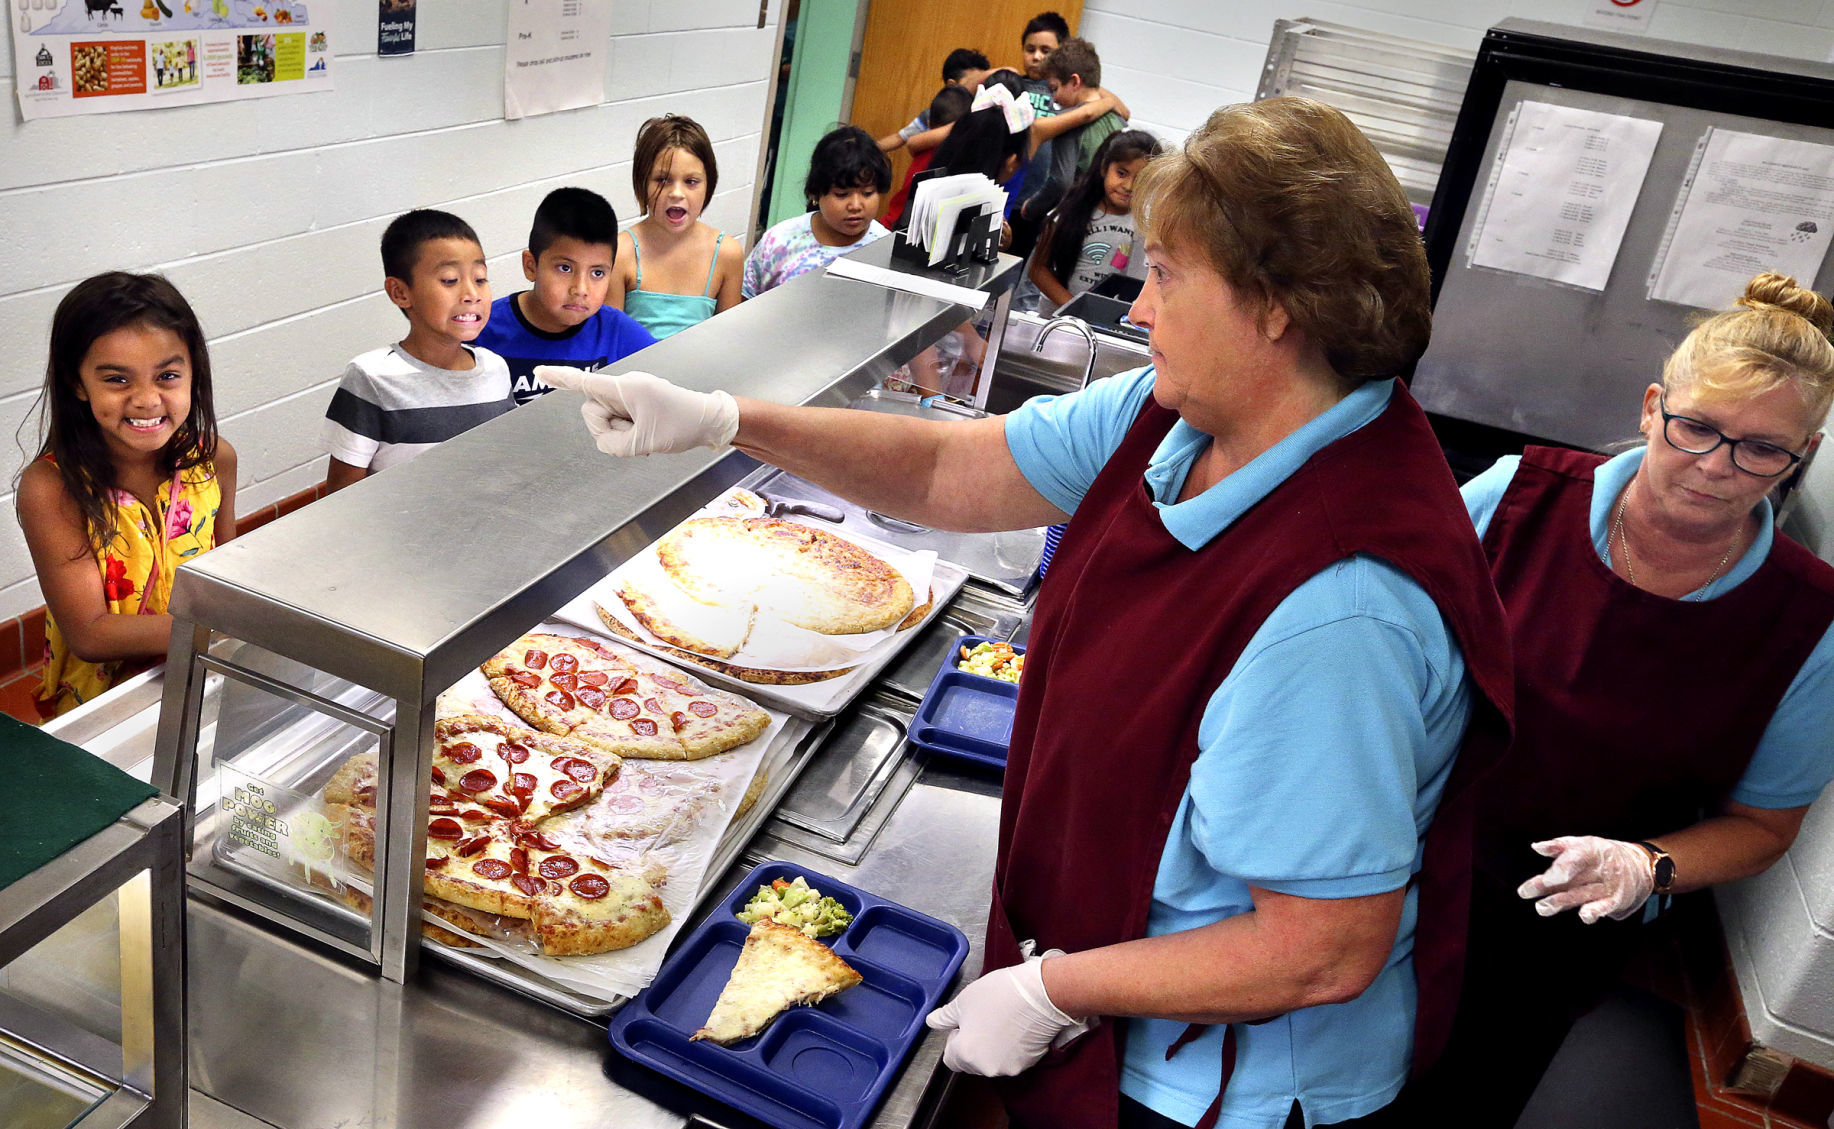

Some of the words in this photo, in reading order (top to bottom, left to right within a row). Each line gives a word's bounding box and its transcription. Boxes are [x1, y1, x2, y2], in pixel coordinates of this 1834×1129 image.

[380, 21, 403, 32] Fueling
[1029, 92, 1050, 110] PIC
[235, 787, 275, 814] MOO
[247, 783, 264, 796] Get
[222, 797, 288, 836] POWER
[232, 816, 244, 827] by
[246, 823, 276, 840] eating
[229, 833, 280, 859] vegetables!
[231, 824, 259, 841] fruits
[260, 837, 278, 849] and
